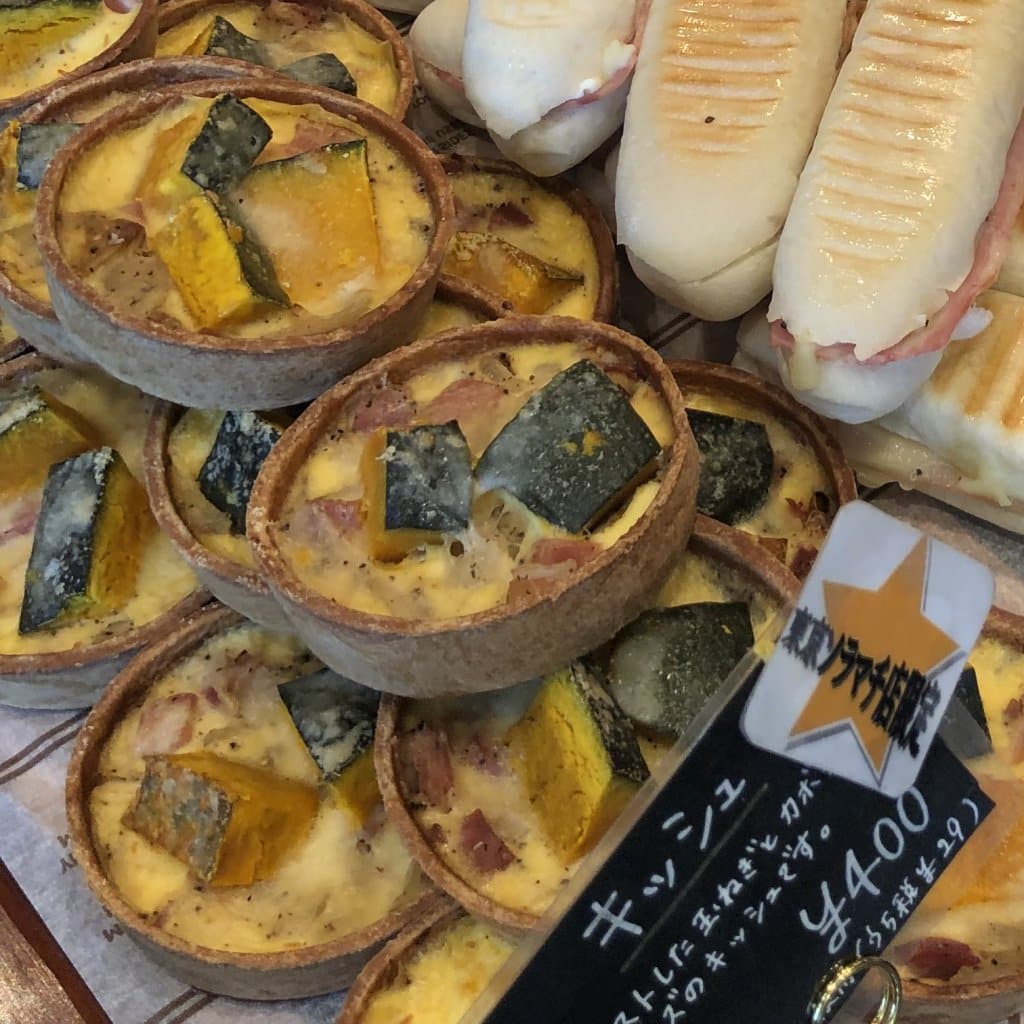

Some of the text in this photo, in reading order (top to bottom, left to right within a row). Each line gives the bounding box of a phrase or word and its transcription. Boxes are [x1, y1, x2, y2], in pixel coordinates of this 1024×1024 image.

[582, 778, 746, 947] キッシュ
[799, 785, 930, 954] ¥400
